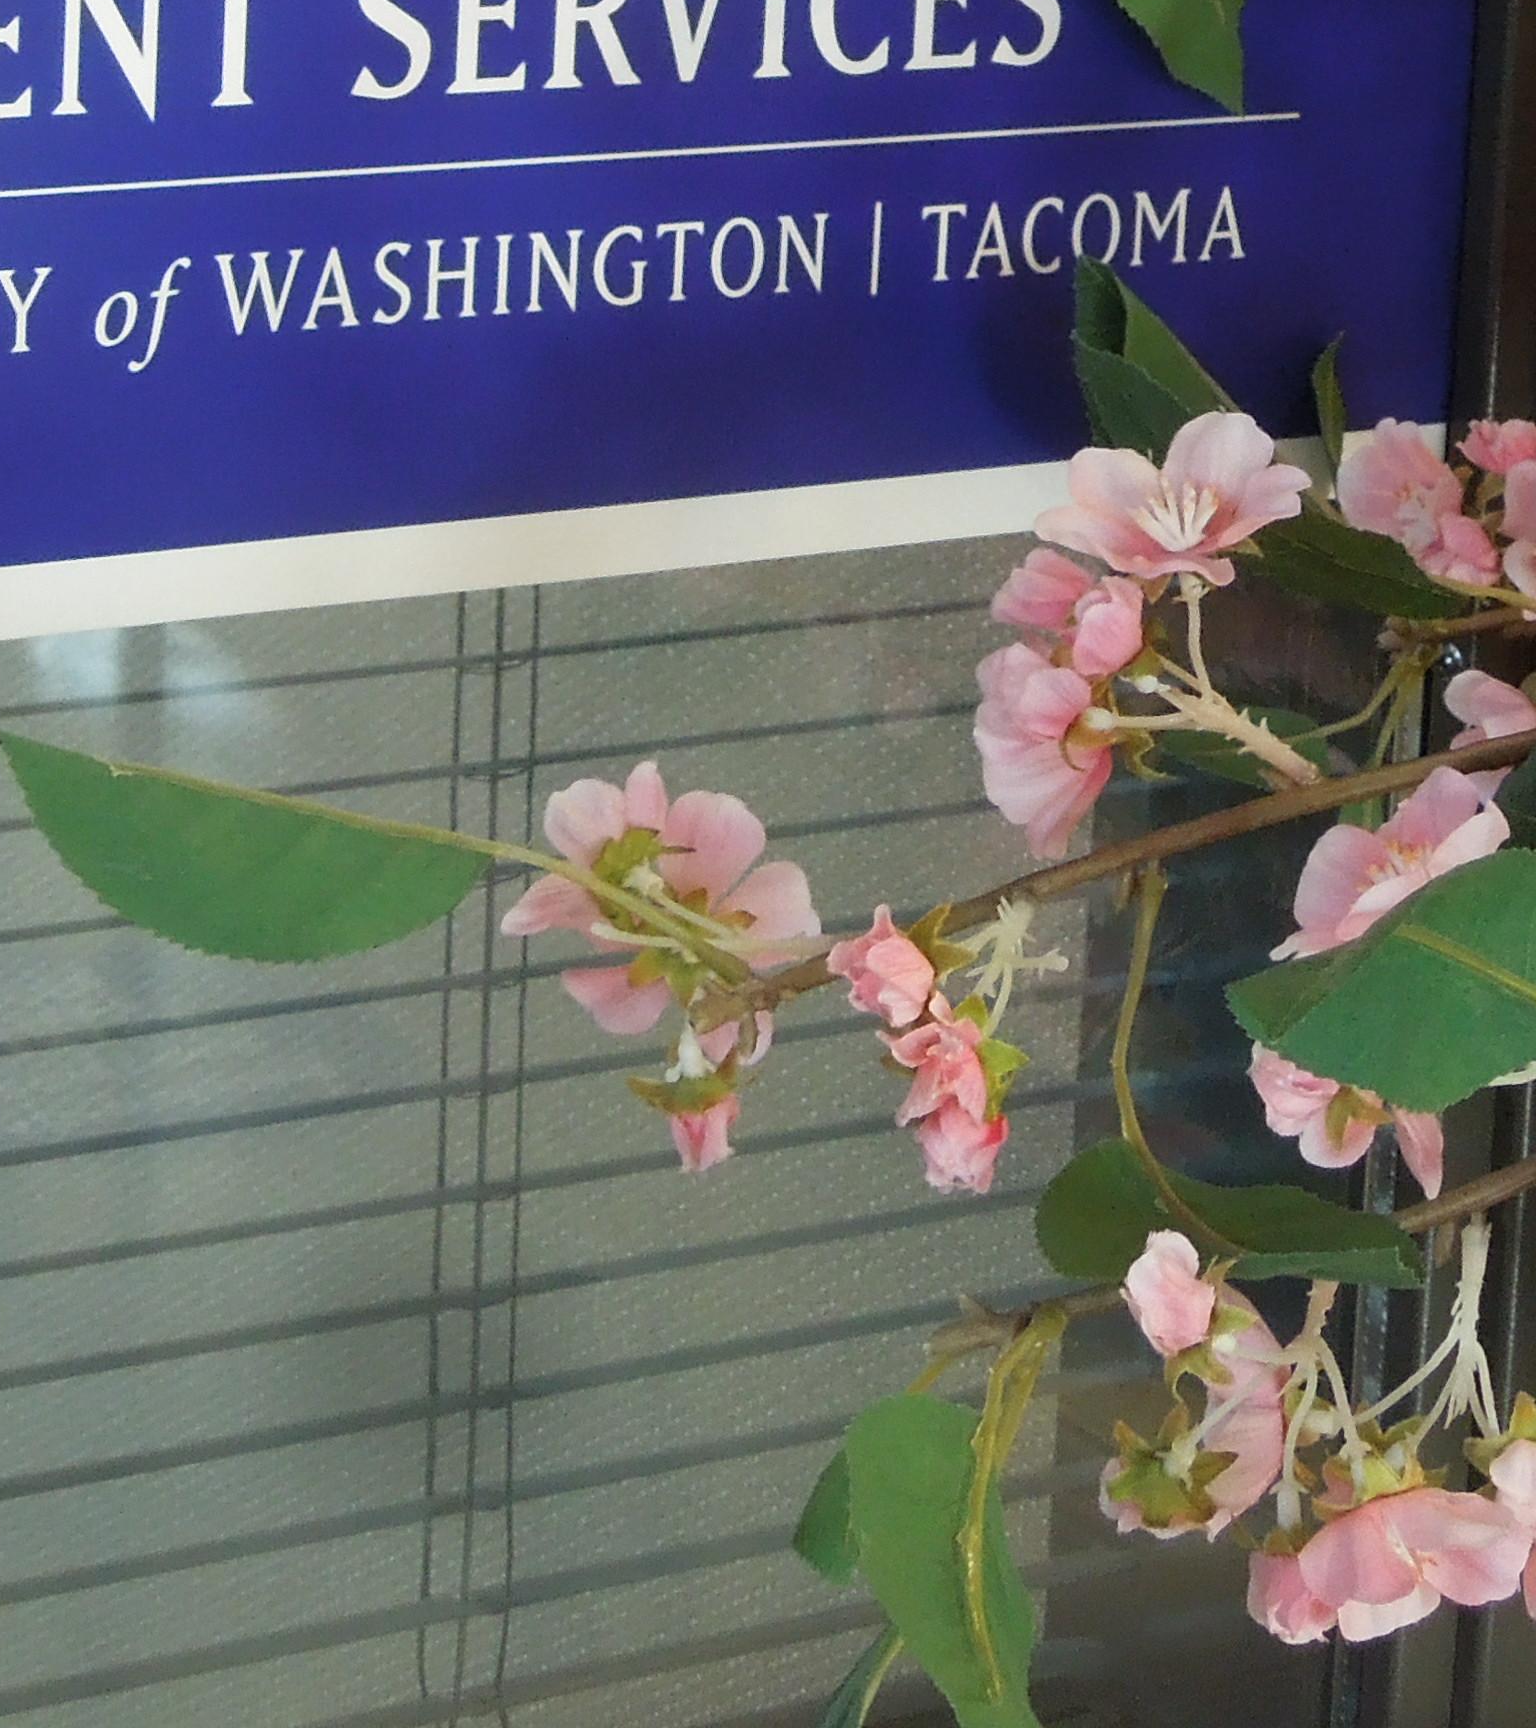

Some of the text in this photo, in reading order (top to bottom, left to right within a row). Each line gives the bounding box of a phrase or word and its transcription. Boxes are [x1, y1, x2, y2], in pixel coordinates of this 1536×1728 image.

[95, 257, 191, 372] of
[215, 214, 828, 335] WASHINGTON
[923, 187, 1244, 280] TACOMA
